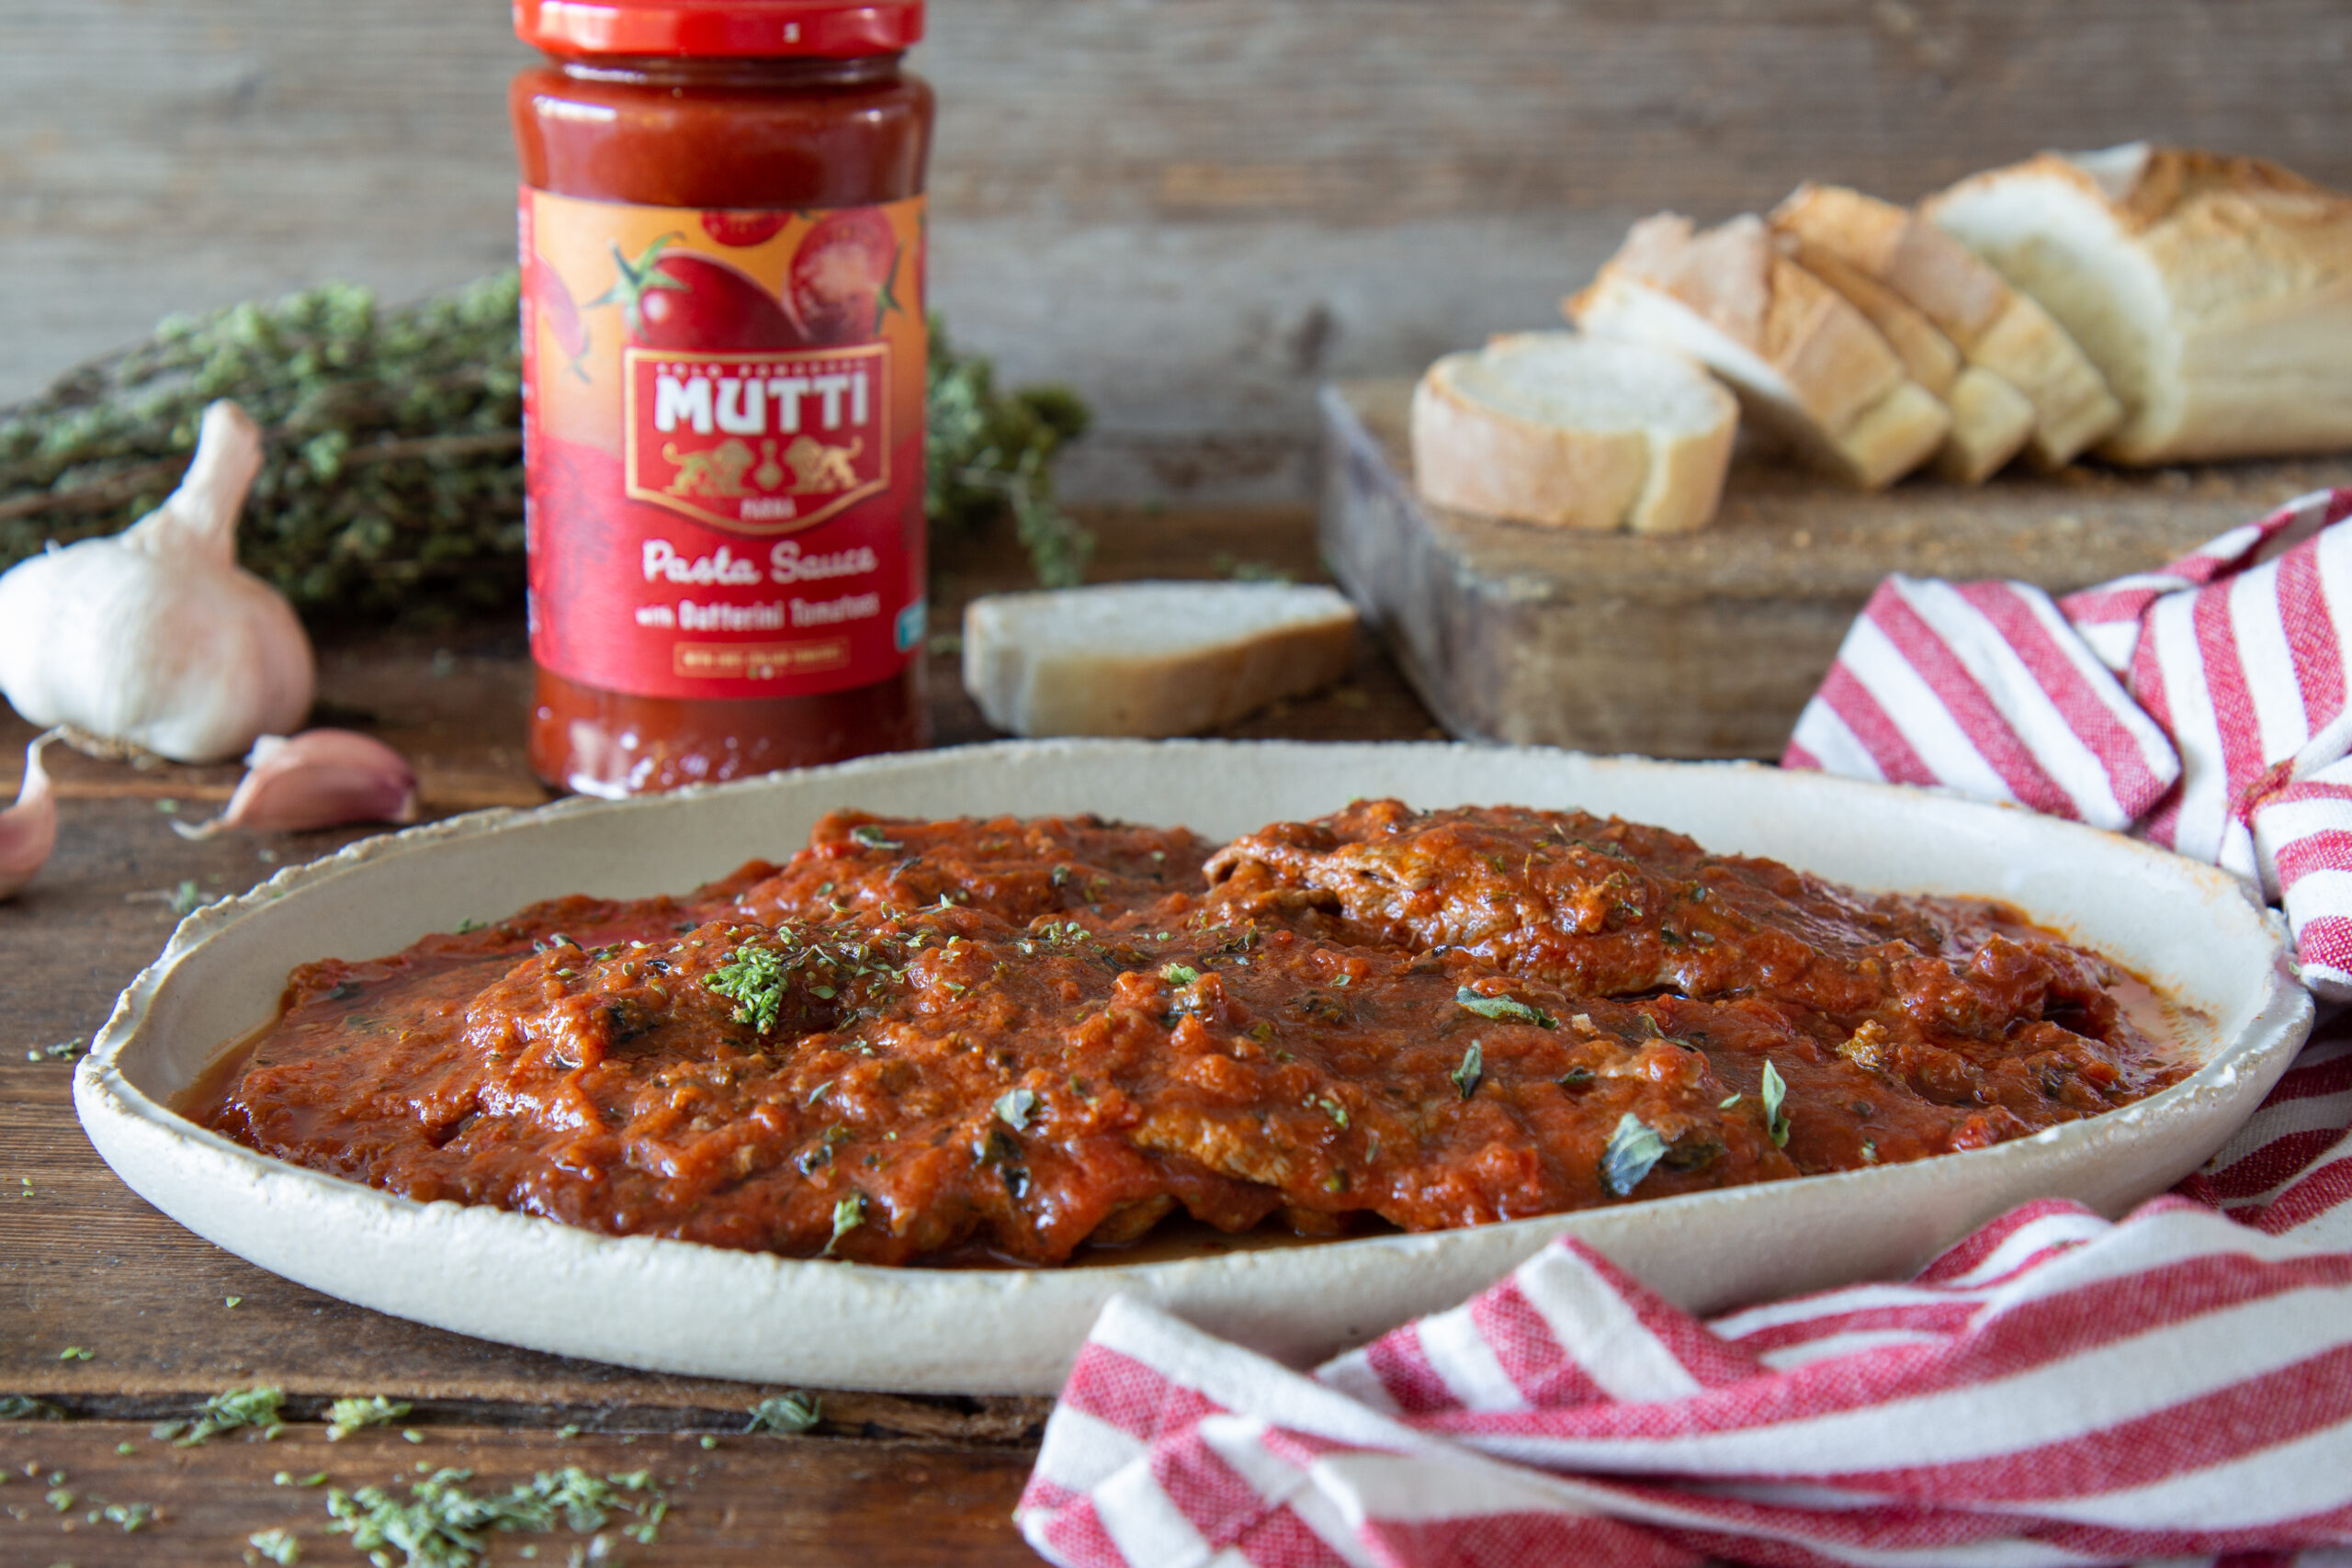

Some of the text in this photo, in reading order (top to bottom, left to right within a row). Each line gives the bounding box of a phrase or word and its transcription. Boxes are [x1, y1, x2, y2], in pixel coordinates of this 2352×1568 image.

[655, 371, 866, 434] MUTTI
[642, 538, 878, 585] Pasta Sauce
